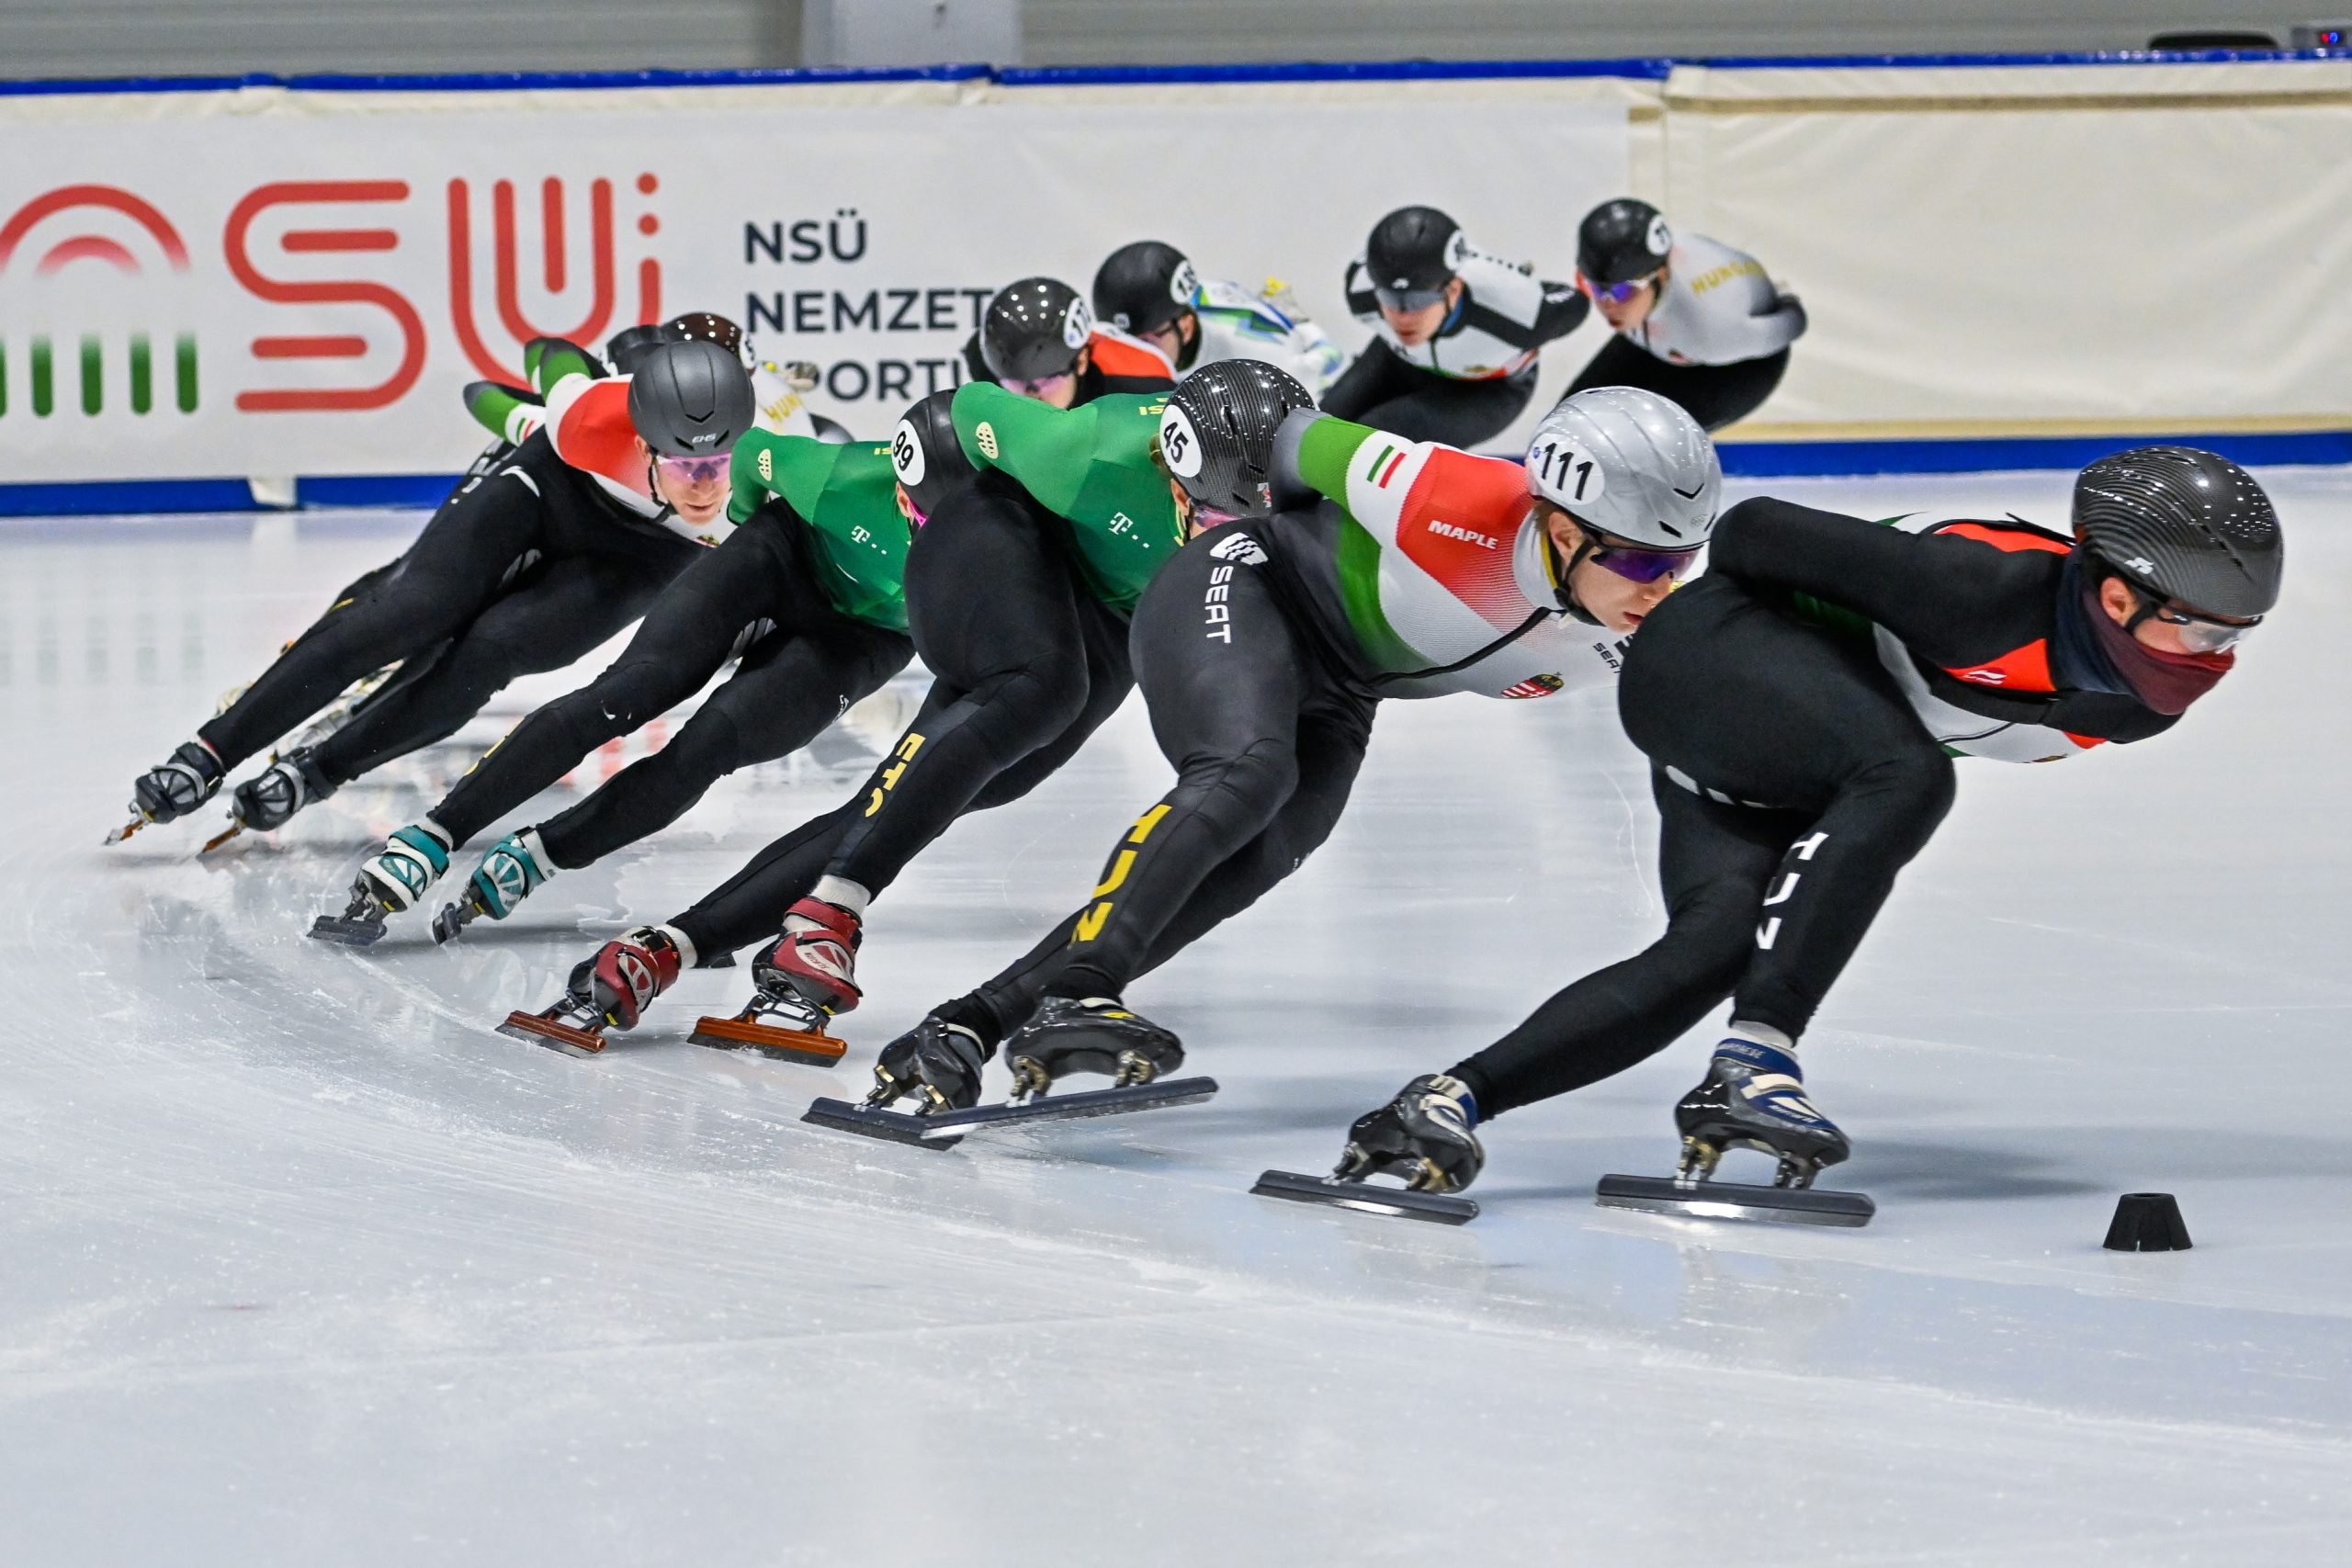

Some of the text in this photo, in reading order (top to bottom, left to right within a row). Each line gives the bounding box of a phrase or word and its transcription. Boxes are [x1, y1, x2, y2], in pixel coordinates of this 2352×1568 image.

[745, 208, 867, 265] NSÜ
[747, 287, 995, 333] NEMZET
[893, 430, 914, 472] 99
[1163, 421, 1190, 464] 45
[1541, 442, 1595, 502] 111
[1427, 519, 1499, 550] MAPLE
[1204, 564, 1235, 644] SEAT
